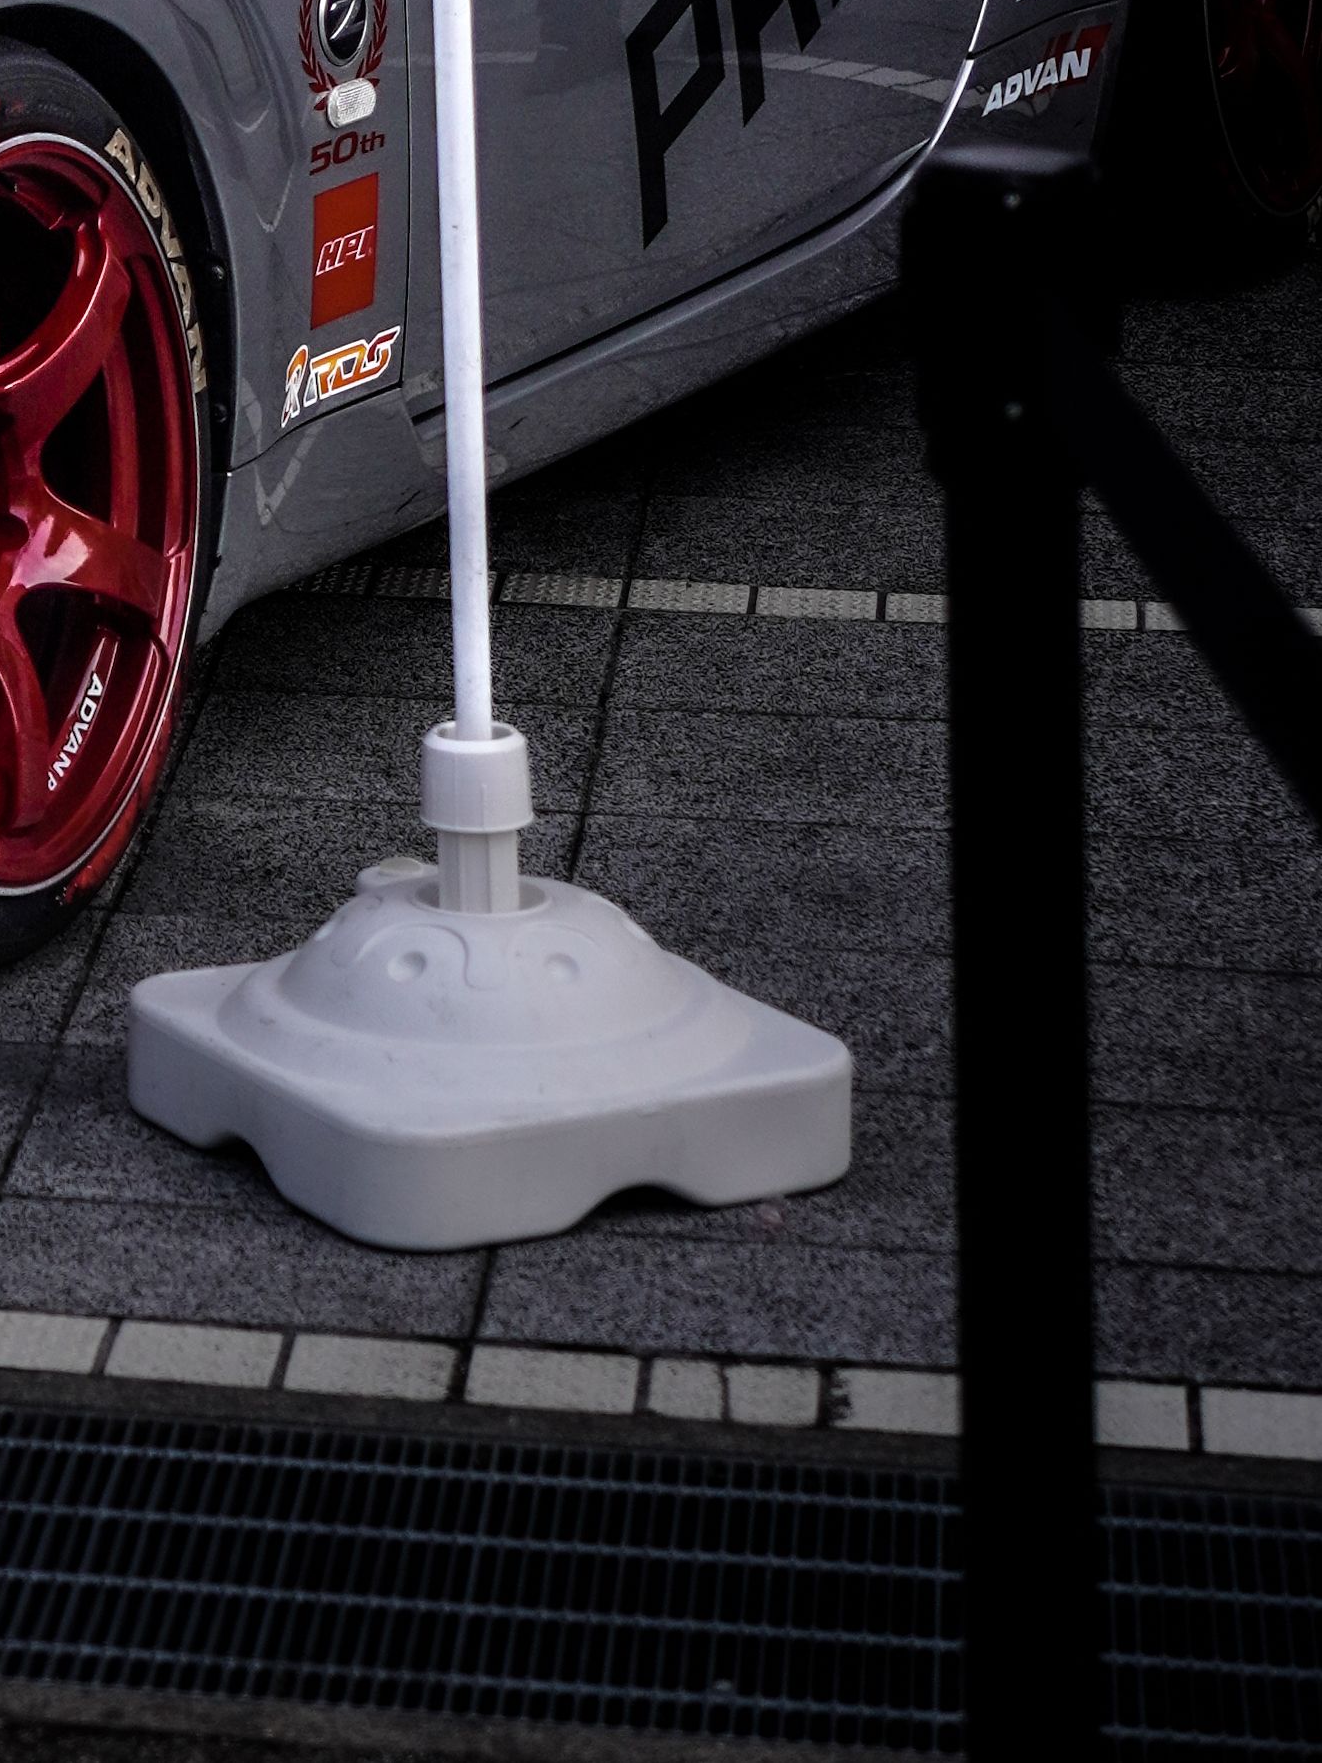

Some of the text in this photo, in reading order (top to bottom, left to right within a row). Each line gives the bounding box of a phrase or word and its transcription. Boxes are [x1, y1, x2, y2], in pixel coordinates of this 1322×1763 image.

[981, 47, 1091, 117] ADVAN
[310, 130, 385, 176] 50th
[104, 127, 207, 395] ADVAN
[314, 224, 375, 277] HPI
[53, 672, 104, 778] ADVAN
